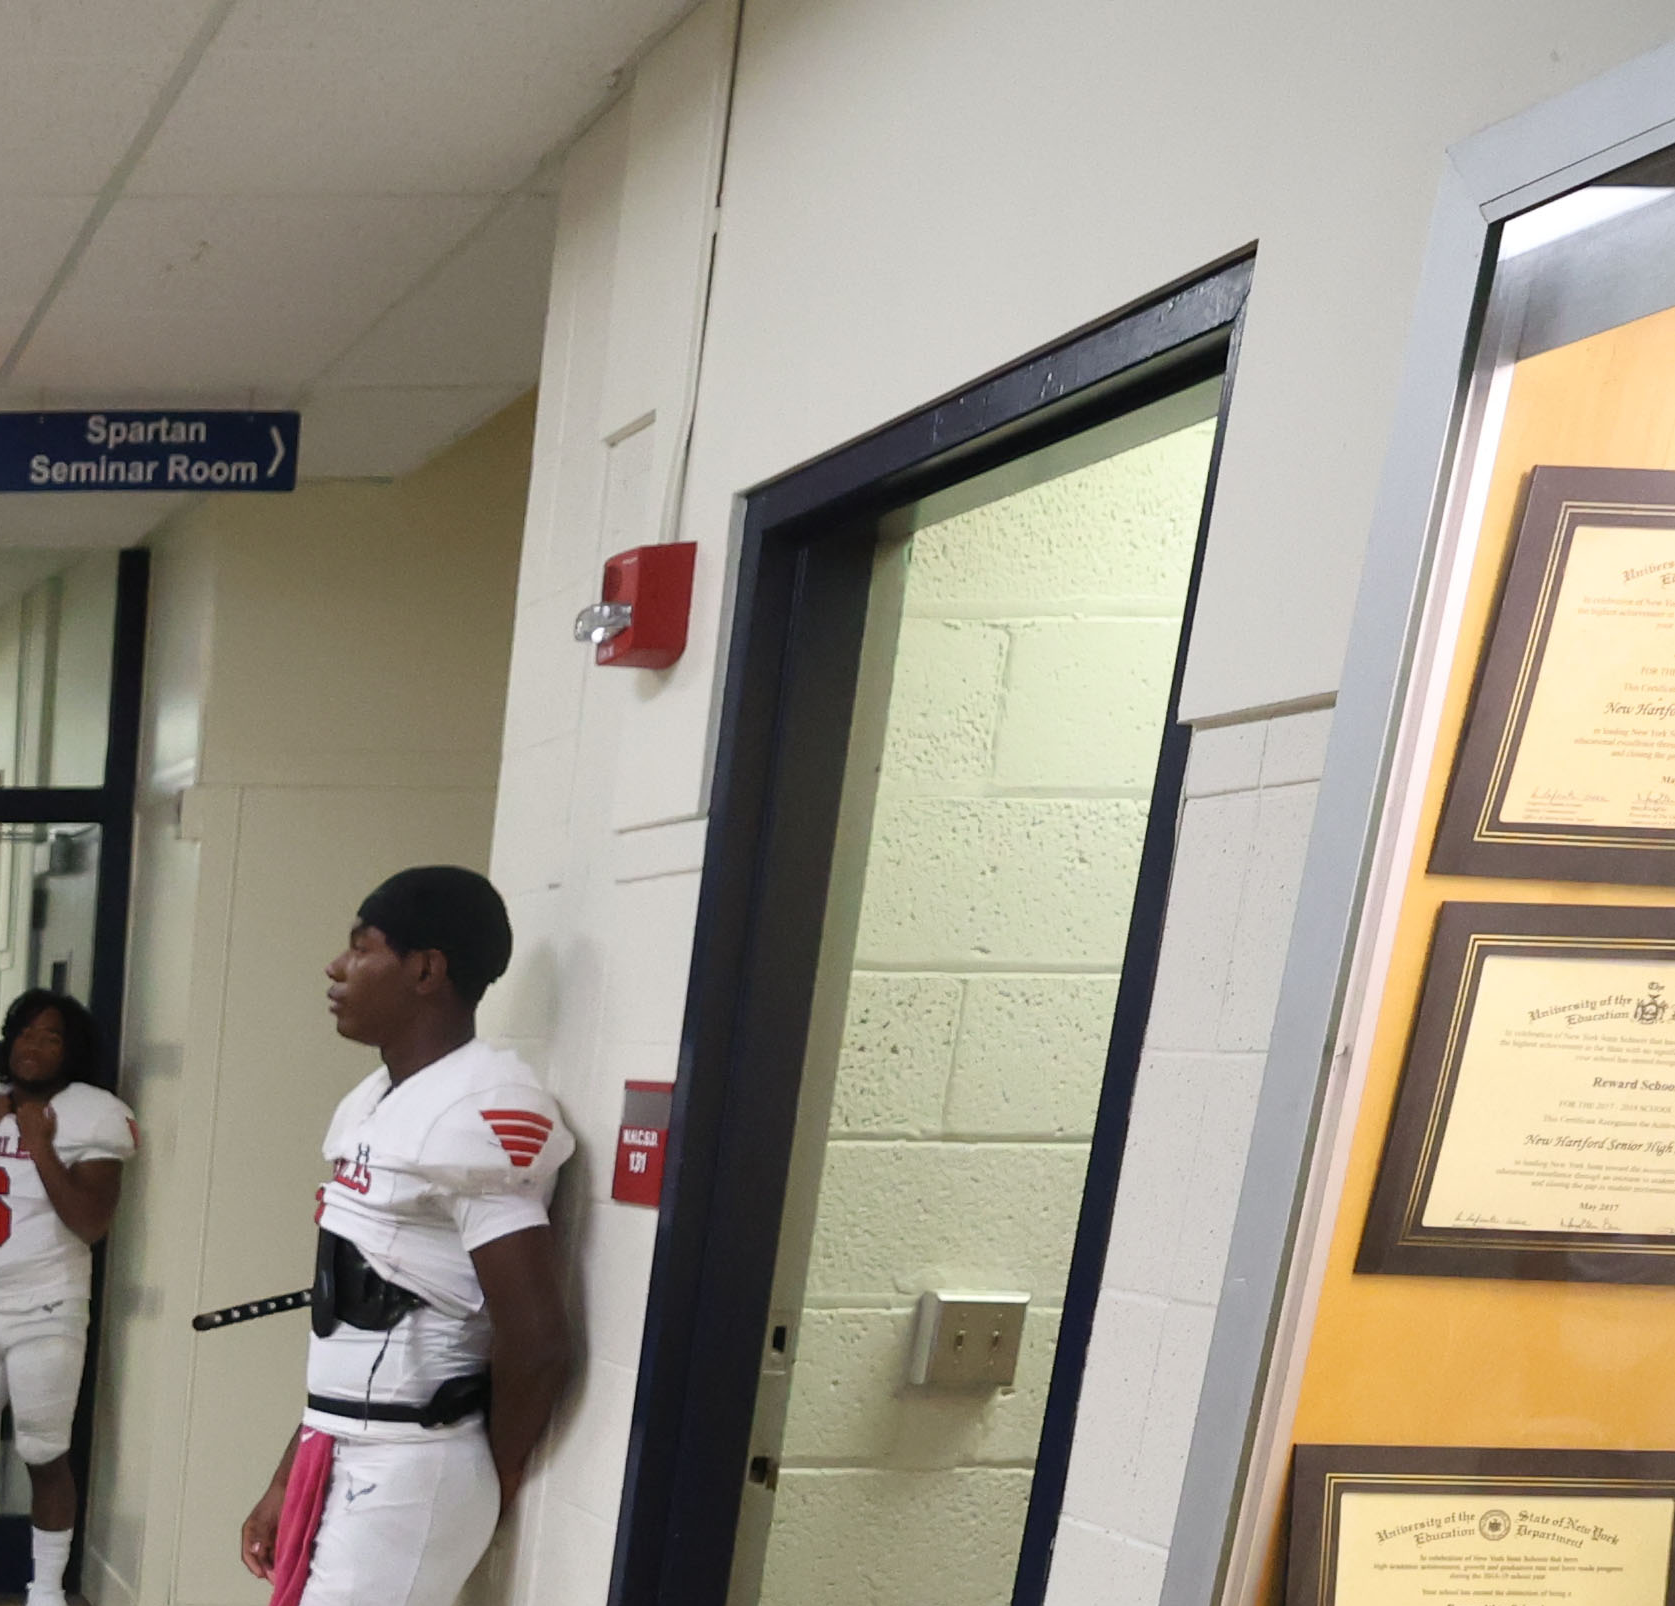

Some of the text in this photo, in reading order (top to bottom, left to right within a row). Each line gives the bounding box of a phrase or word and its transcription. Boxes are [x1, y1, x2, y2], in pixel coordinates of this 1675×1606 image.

[86, 415, 206, 449] Spartan
[30, 454, 258, 484] Seminar Room
[1527, 998, 1597, 1023] University
[1564, 1009, 1630, 1026] Education
[1592, 1077, 1675, 1092] Reward Schoo
[1524, 1135, 1673, 1156] New Hartford Senior High
[1374, 1509, 1621, 1546] University of the State of New York
[1414, 1524, 1584, 1549] Education Department
